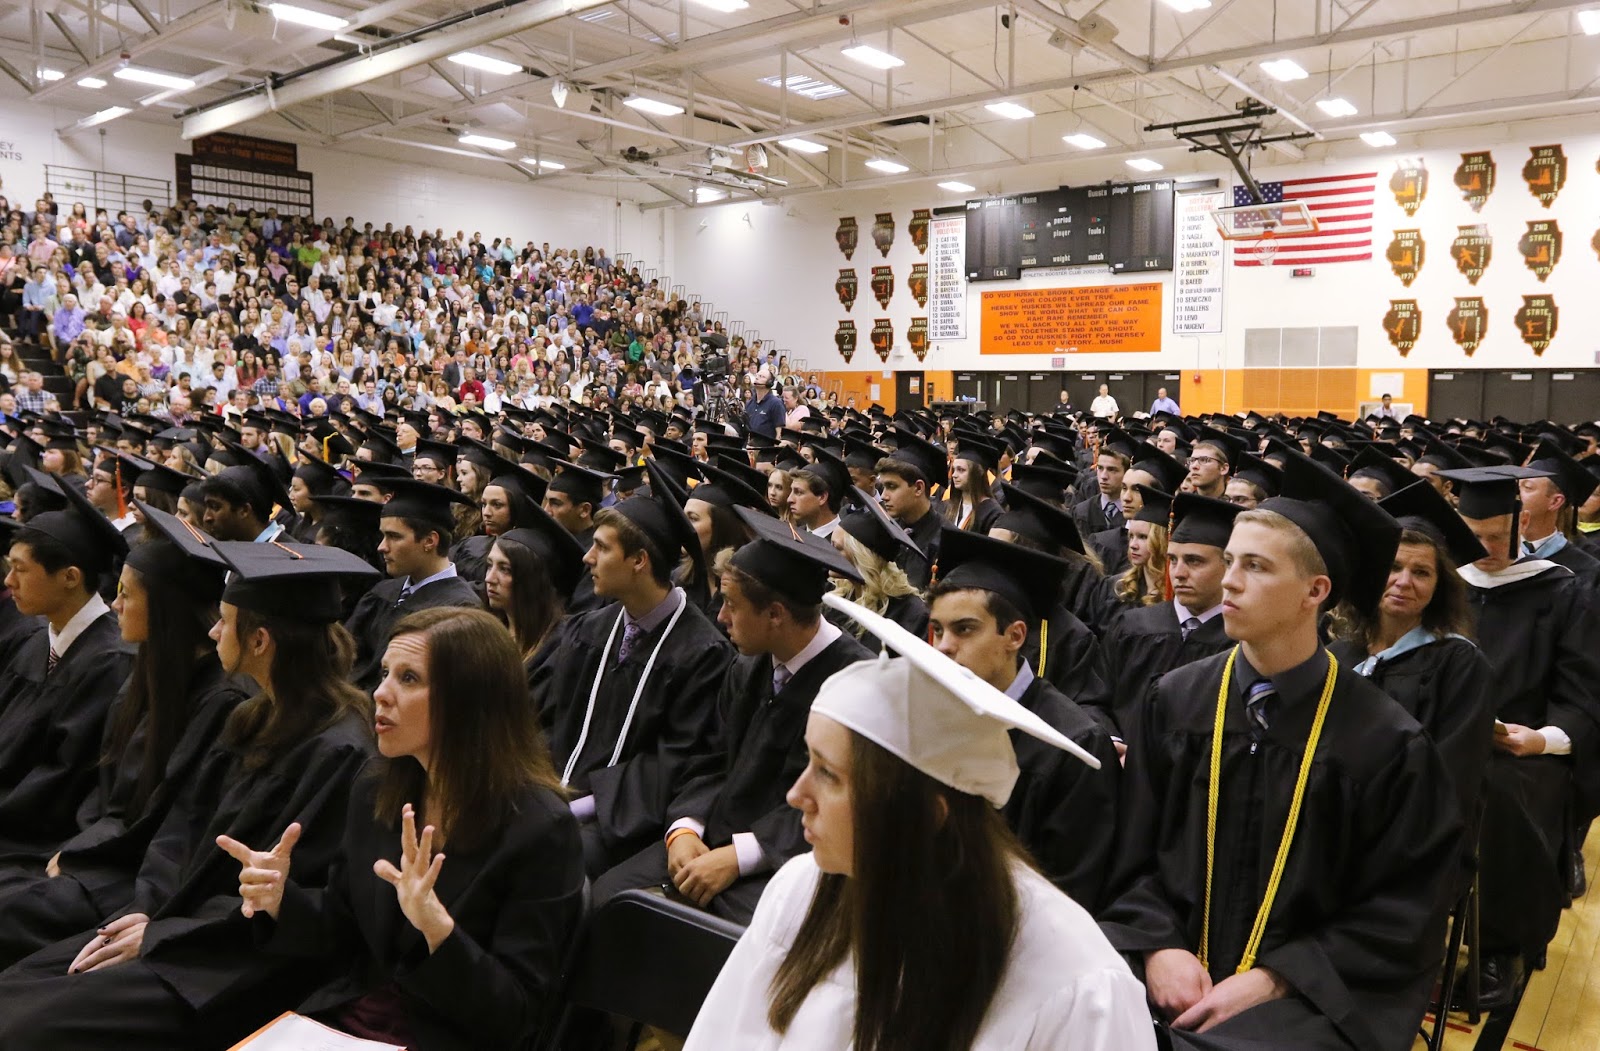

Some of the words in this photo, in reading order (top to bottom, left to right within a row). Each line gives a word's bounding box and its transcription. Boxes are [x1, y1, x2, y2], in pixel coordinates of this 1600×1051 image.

[1539, 149, 1553, 157] 3RD
[1470, 156, 1483, 164] 3RD
[1533, 157, 1556, 166] STATE
[1465, 164, 1487, 172] STATE
[1112, 186, 1129, 195] player
[1133, 184, 1150, 193] points
[967, 202, 981, 210] player
[1054, 216, 1071, 225] period
[1534, 223, 1548, 231] 2ND
[1053, 230, 1071, 238] player
[1397, 232, 1418, 240] STATE
[1529, 234, 1552, 242] STATE
[1470, 237, 1492, 245] STATE
[1053, 255, 1070, 263] weight
[1088, 253, 1104, 261] match
[1532, 299, 1545, 307] 3RD
